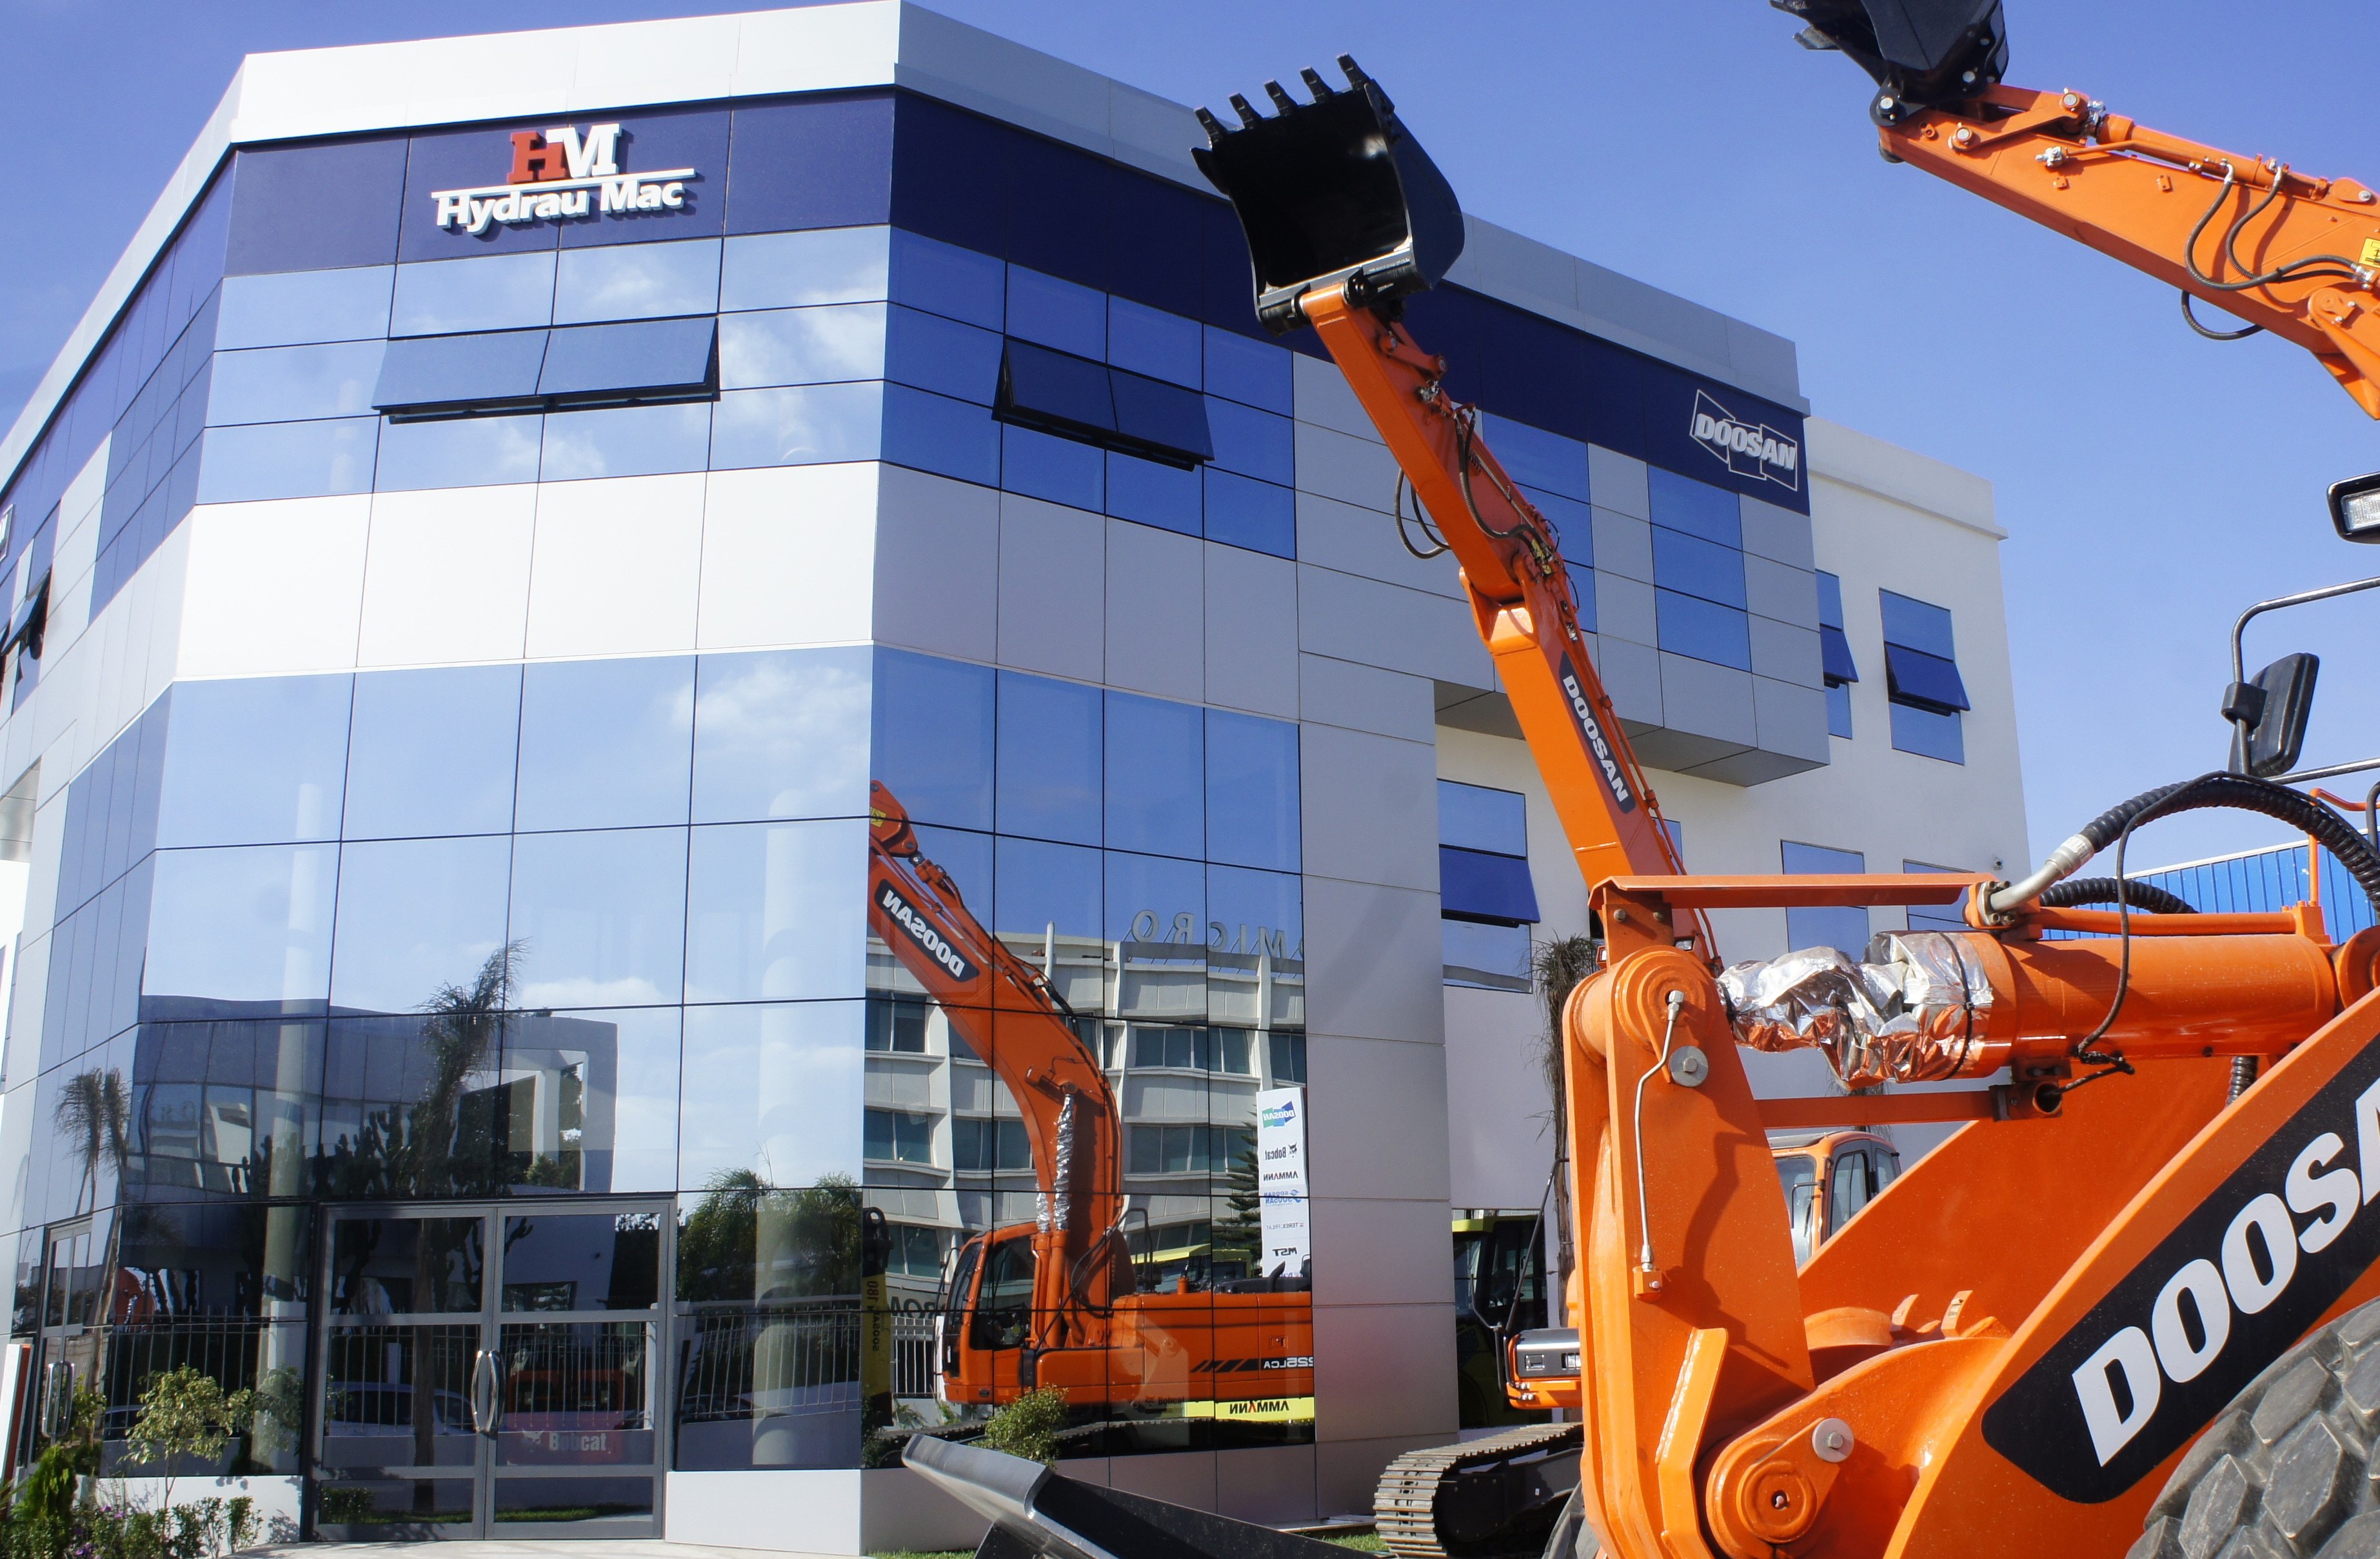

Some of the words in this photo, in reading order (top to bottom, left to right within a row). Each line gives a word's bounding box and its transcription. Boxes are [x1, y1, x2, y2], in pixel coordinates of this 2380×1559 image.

[506, 123, 622, 184] HM
[436, 190, 590, 235] Hydrau
[600, 180, 686, 215] Mac
[1694, 413, 1796, 471] DOOSAN
[1563, 675, 1629, 802] DOOSAN
[549, 1432, 607, 1451] Bobcat
